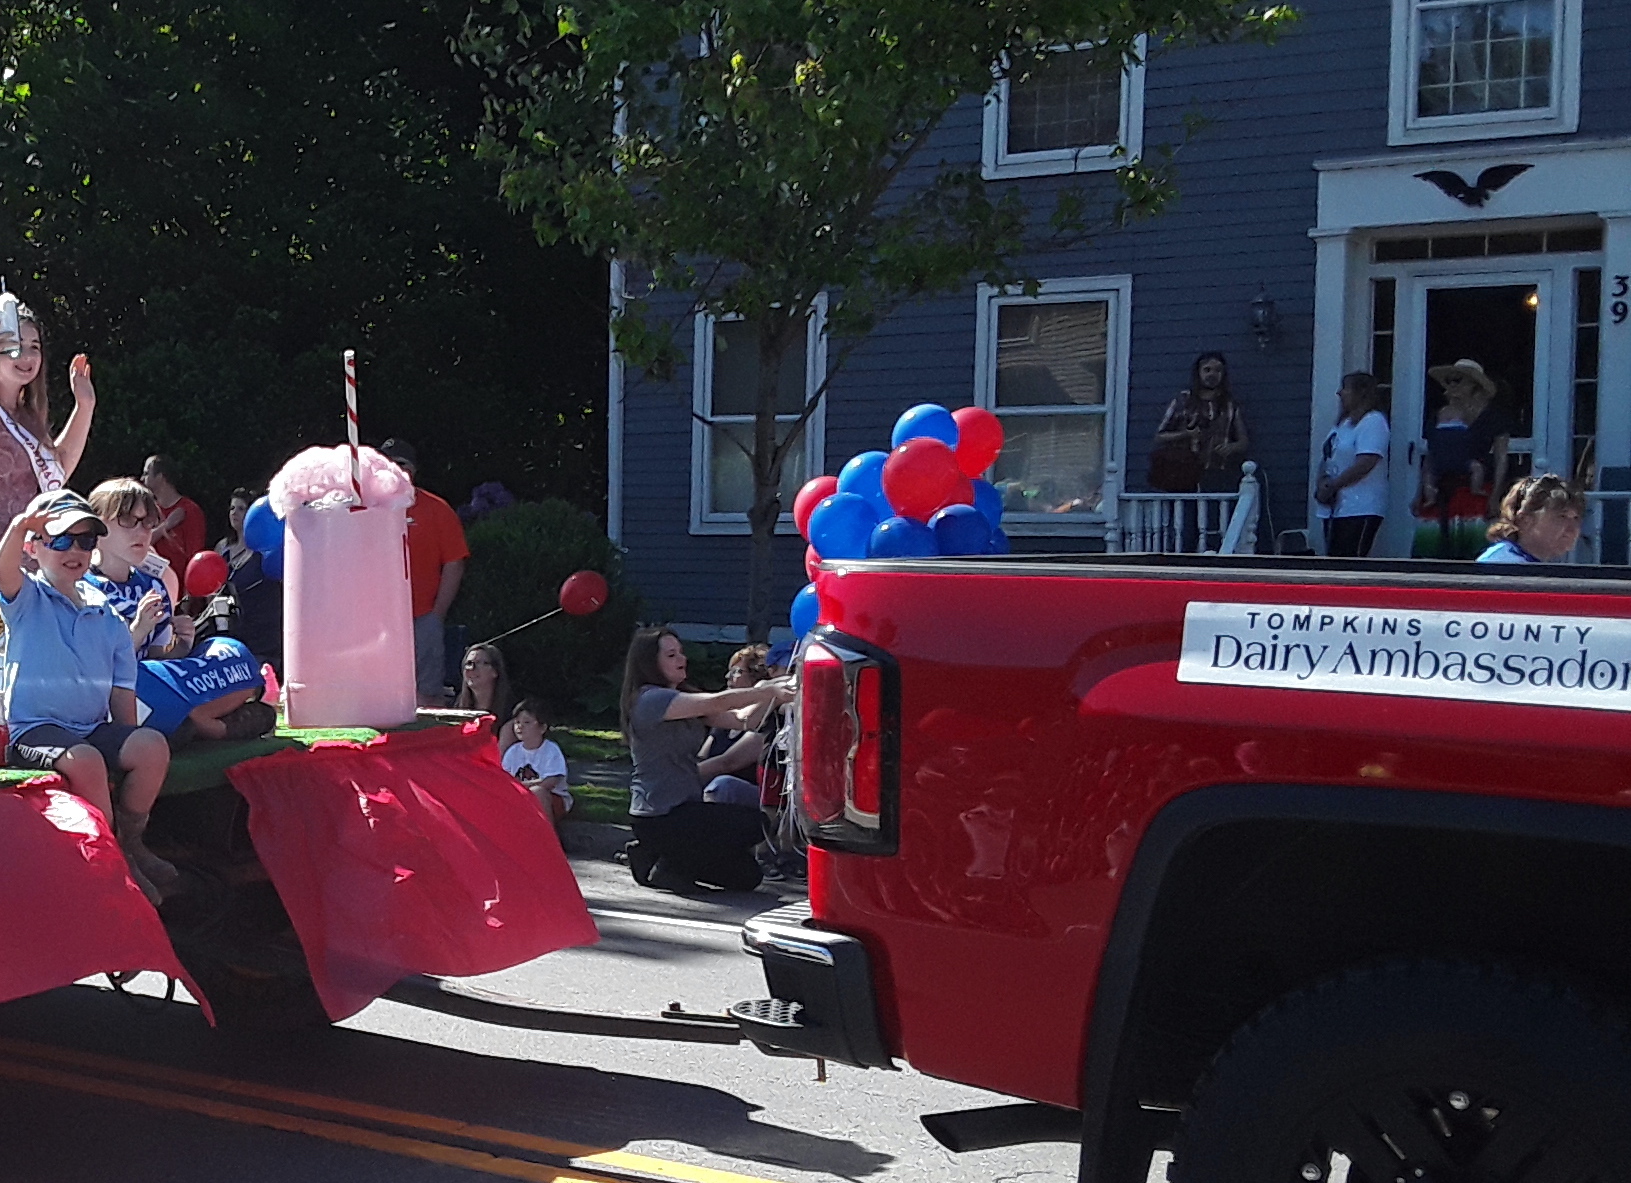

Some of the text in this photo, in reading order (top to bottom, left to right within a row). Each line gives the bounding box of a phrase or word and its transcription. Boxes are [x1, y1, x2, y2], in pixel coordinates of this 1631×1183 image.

[1246, 611, 1593, 645] TOMPKINS COUNTY
[1210, 633, 1330, 680] Dairy
[185, 662, 253, 695] 100% DAILY
